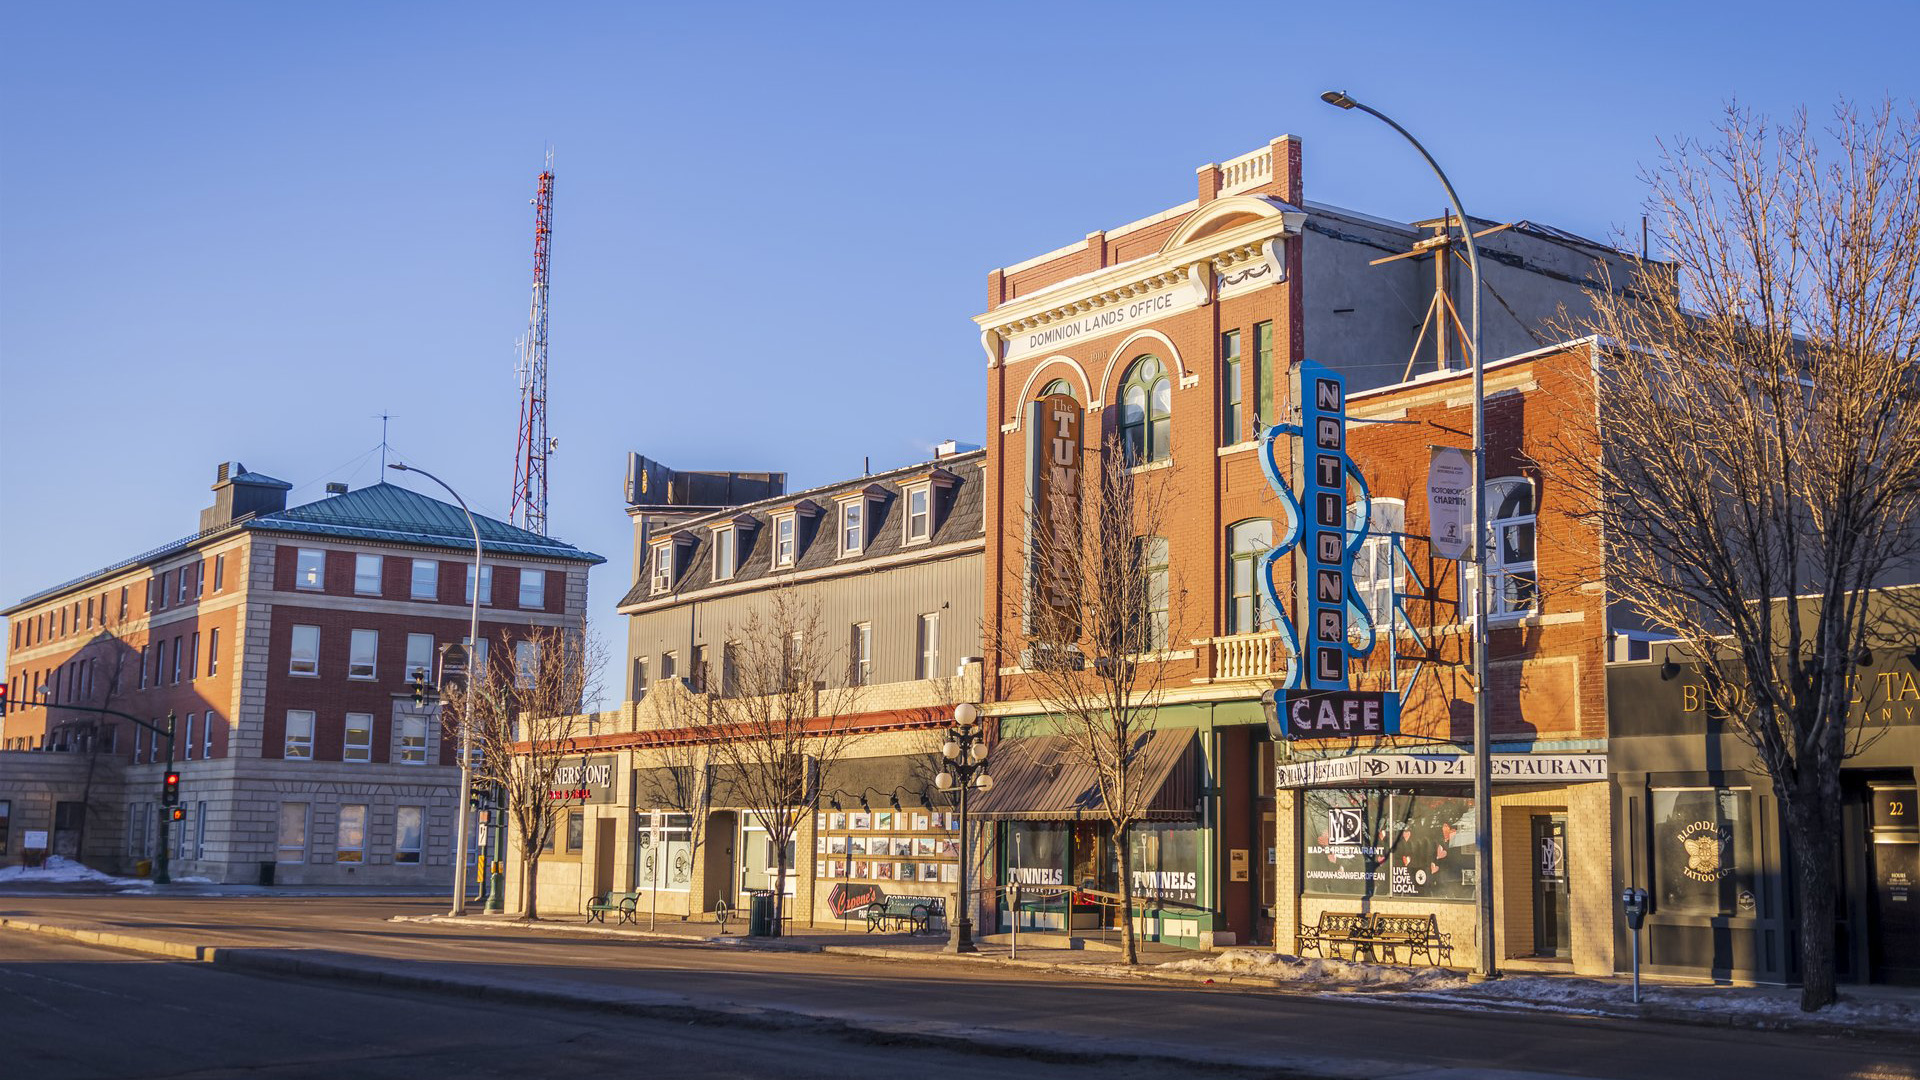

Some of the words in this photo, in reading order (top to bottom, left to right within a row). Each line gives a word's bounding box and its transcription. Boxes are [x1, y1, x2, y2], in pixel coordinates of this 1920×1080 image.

[1030, 321, 1081, 349] DOMINION
[1085, 308, 1125, 333] LANDS
[1130, 293, 1173, 318] OFFICE
[1051, 398, 1073, 412] The
[1292, 698, 1380, 730] CAFE
[1396, 761, 1437, 775] MAD
[1443, 760, 1467, 775] 24
[1474, 760, 1607, 775] ESTAURANT
[1889, 802, 1904, 816] 22
[1677, 820, 1733, 844] BLOODLINE
[1132, 871, 1196, 890] TUNNELS
[1393, 876, 1413, 885] LOVE.
[1683, 866, 1715, 882] TATTOO
[1179, 890, 1196, 900] Jaw
[1393, 885, 1419, 894] LOCAL.
